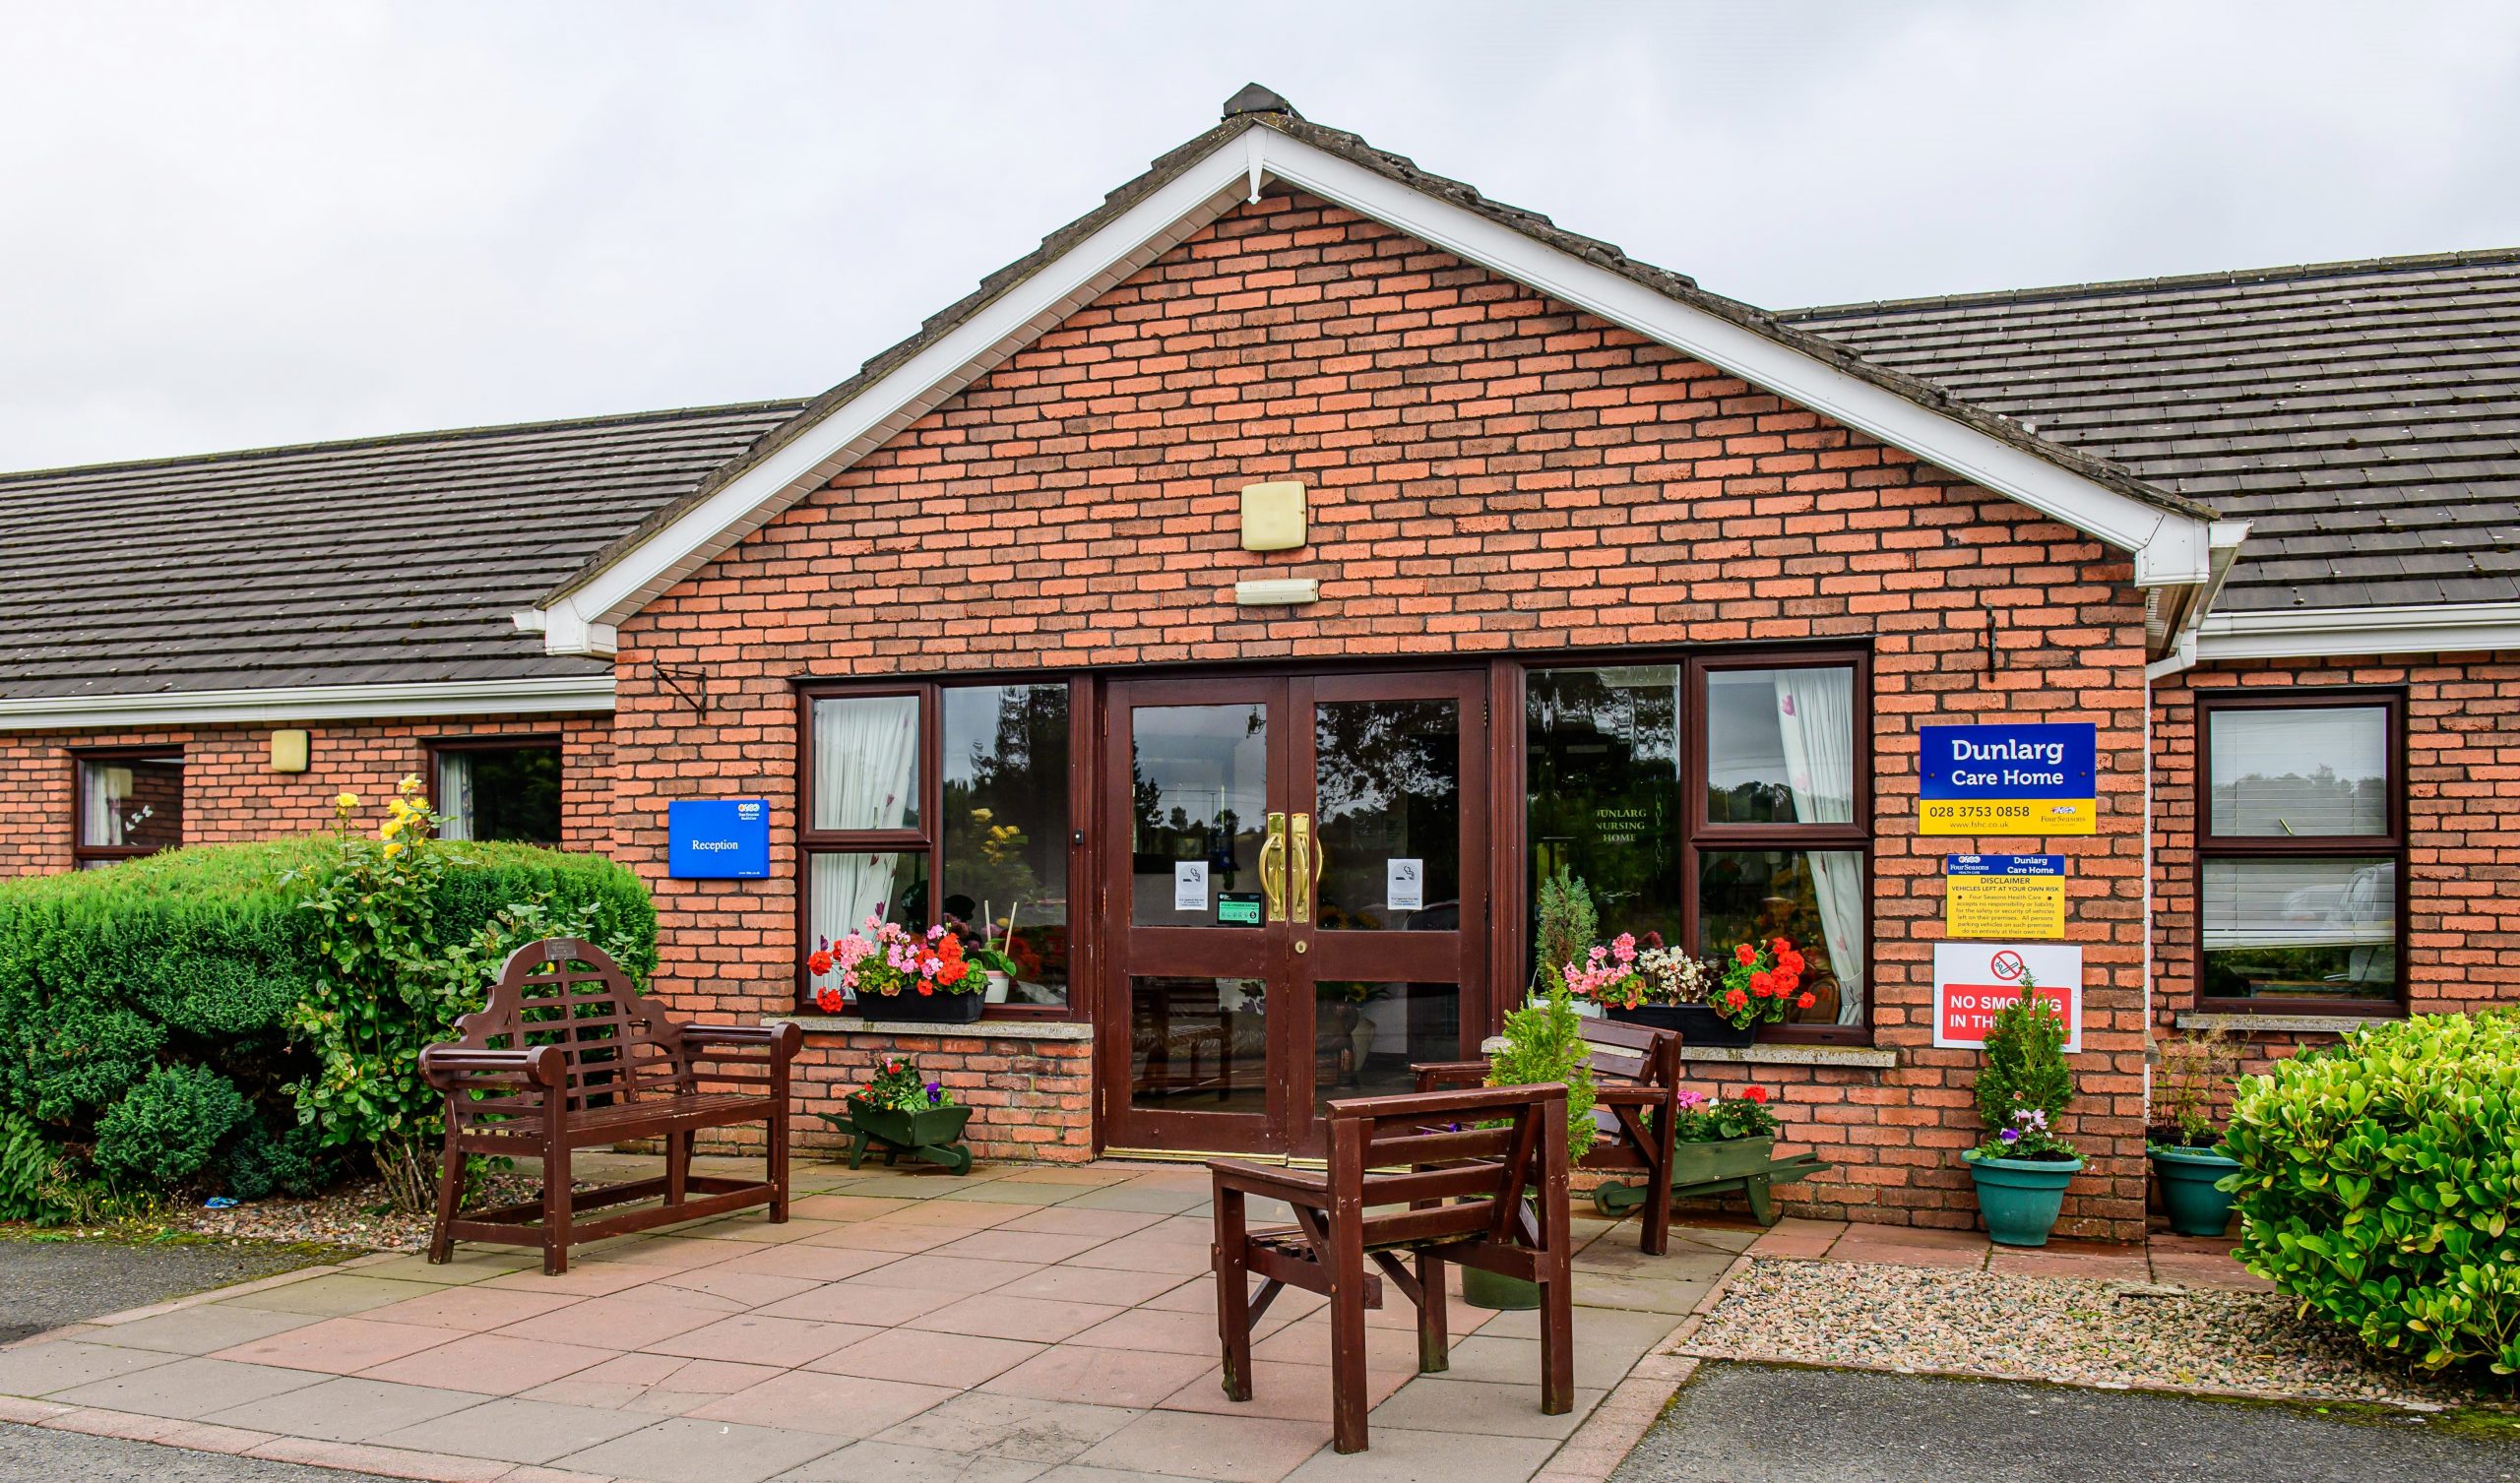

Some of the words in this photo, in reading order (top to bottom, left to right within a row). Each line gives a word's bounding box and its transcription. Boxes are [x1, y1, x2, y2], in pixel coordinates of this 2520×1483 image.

[1952, 739, 2064, 765] Dunlarg
[1952, 770, 1997, 785] Care
[2003, 770, 2064, 785] Home
[1930, 807, 1954, 817] 028
[1959, 806, 1991, 817] 3753
[1996, 806, 2030, 816] 0858
[1596, 822, 1645, 830] NURSING
[1603, 834, 1637, 842] HOME
[693, 839, 738, 852] Reception
[2014, 857, 2048, 865] Dunlarg
[1951, 996, 1975, 1008] NO
[1951, 1015, 1966, 1027] IN
